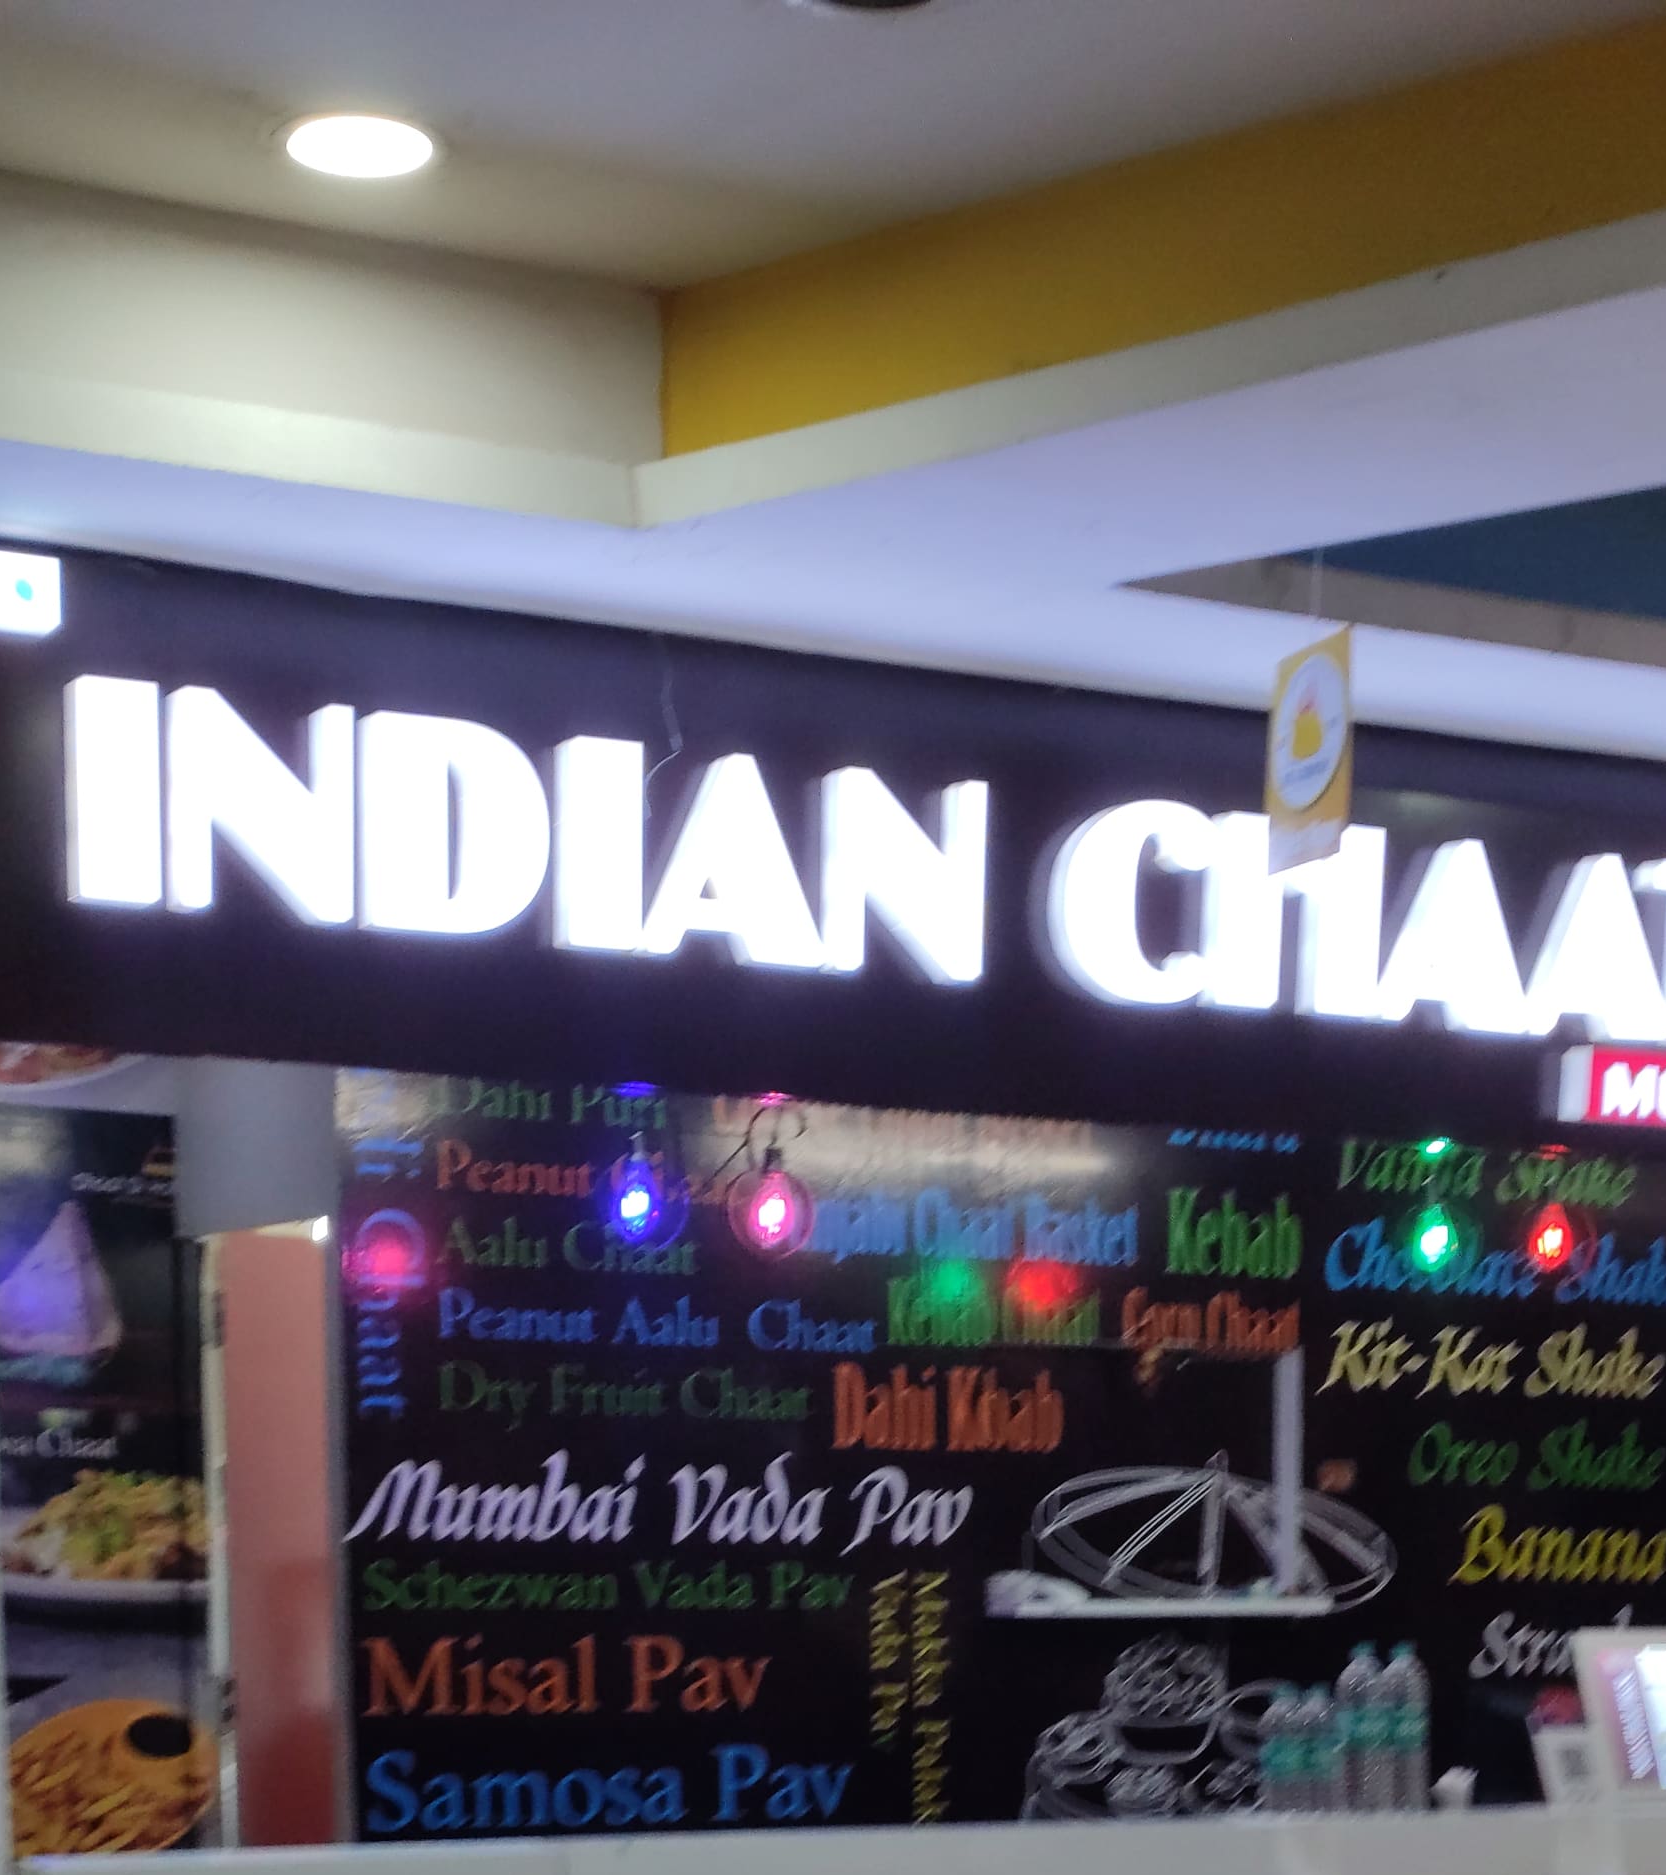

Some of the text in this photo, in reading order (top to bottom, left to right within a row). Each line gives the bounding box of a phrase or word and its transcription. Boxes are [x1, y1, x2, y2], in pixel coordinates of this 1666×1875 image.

[63, 673, 991, 984] INDIAN
[436, 1138, 597, 1198] Peanut
[437, 1214, 549, 1271] Aalu
[1165, 1185, 1304, 1281] Kebab
[438, 1285, 880, 1355] Peanut Aalu Chaat
[1315, 1316, 1525, 1400] Kit-Kat
[1523, 1321, 1666, 1400] Shake
[438, 1358, 814, 1434] Dry Fruit Chaat
[833, 1361, 938, 1451] Dahi
[1407, 1420, 1520, 1488] Oreo
[1530, 1416, 1666, 1492] Shake
[341, 1448, 974, 1557] Mumbai Vada Pav
[360, 1557, 855, 1612] Schezwan Vada Pav
[359, 1632, 775, 1718] Misal Pav
[365, 1742, 855, 1834] Samosa Pav
